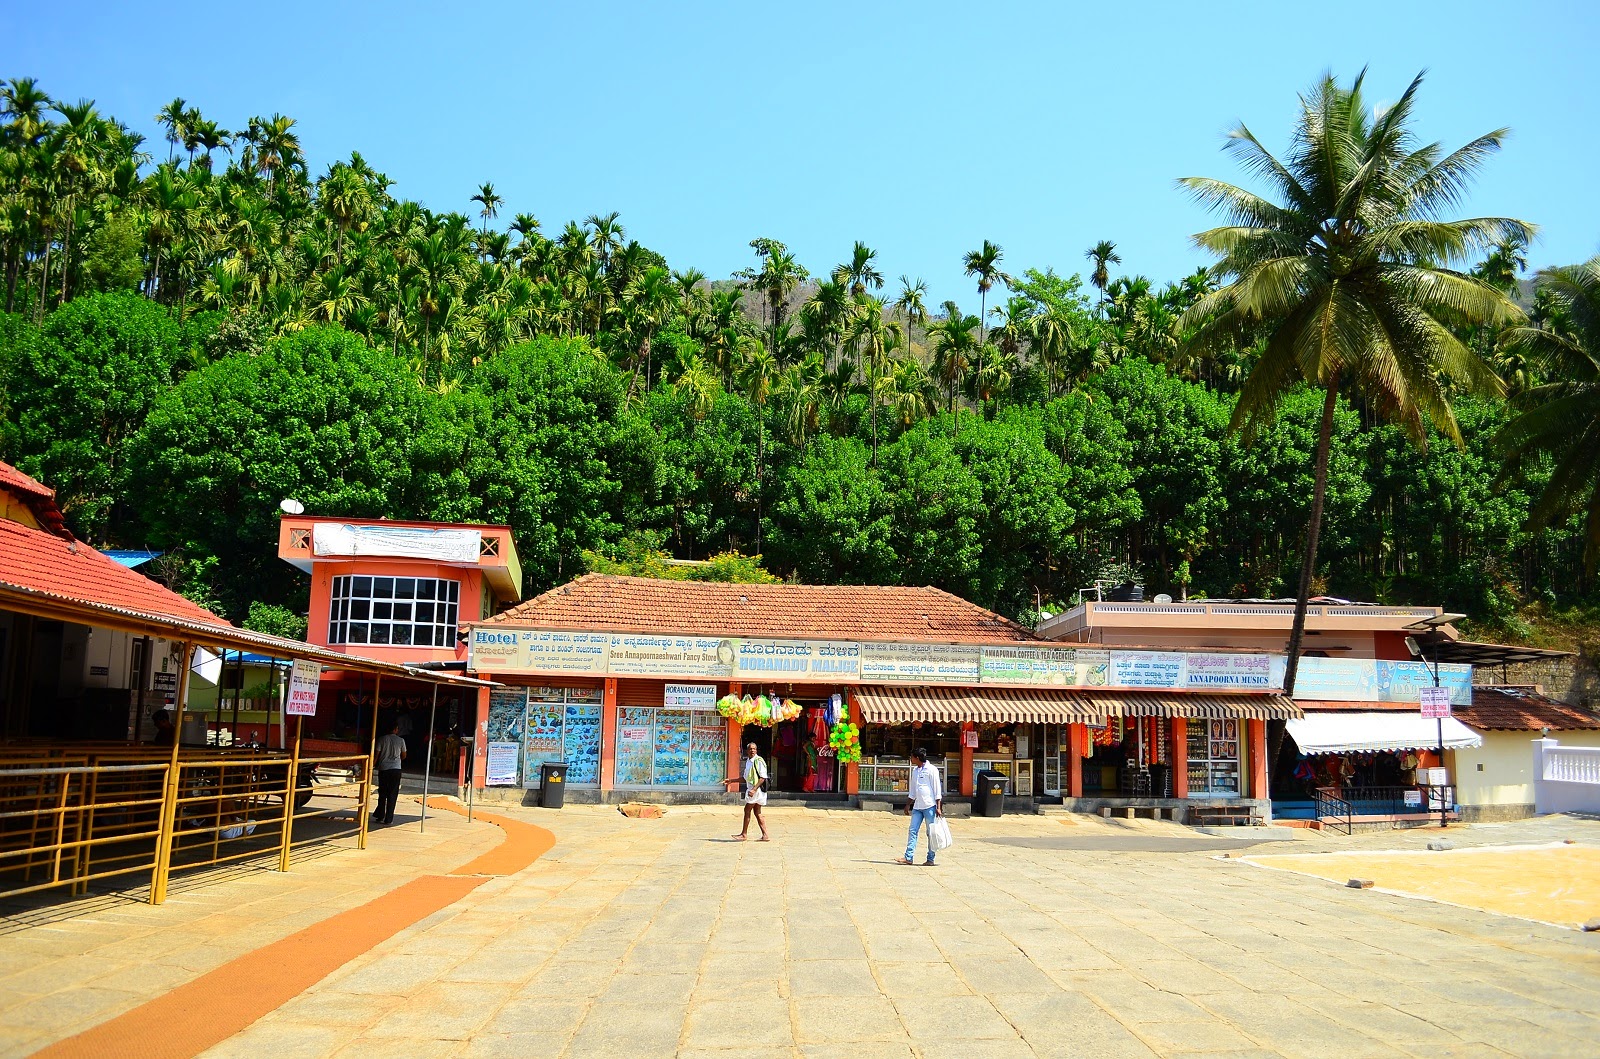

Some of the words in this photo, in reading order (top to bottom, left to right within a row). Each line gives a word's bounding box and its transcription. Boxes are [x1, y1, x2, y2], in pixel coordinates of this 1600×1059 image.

[475, 631, 518, 645] Hotel
[611, 636, 620, 648] ಶ್ರೀ
[739, 641, 812, 655] ಹೊರನಾಡು
[819, 643, 859, 657] ಮಳಿಗೆ
[985, 649, 1016, 659] ANNAPURNA
[1018, 651, 1036, 659] COFFEE
[1041, 651, 1051, 660] TEA
[1052, 652, 1075, 660] AGENCIES
[610, 650, 624, 659] Sree
[683, 652, 701, 663] Fancy
[702, 653, 717, 662] Store
[739, 657, 808, 672] HORANADU
[1188, 675, 1239, 683] ANNAPOORNA
[1241, 675, 1269, 684] MUSICS
[665, 686, 695, 694] HORANADU
[696, 687, 715, 695] MALIGE
